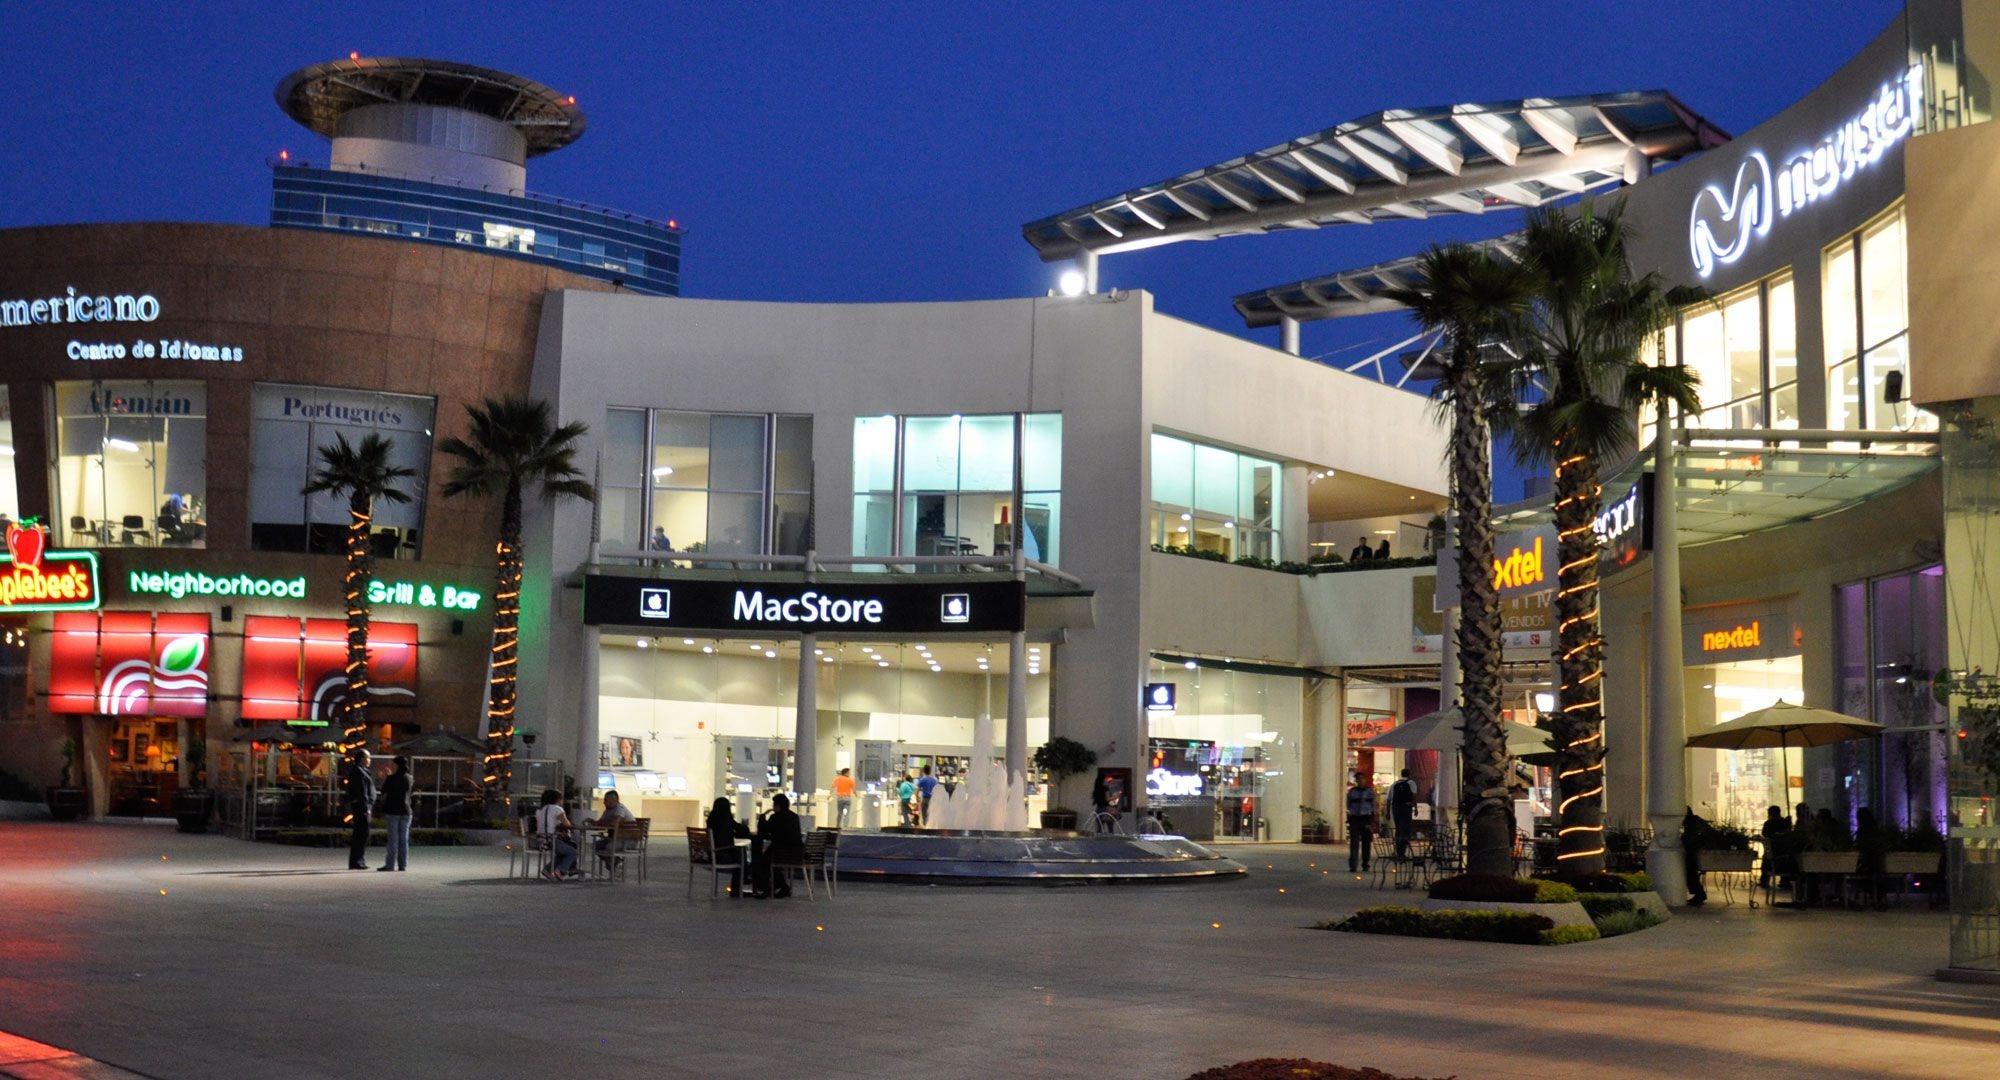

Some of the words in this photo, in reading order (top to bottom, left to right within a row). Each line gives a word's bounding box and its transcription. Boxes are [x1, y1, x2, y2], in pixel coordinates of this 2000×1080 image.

[0, 286, 160, 326] mericano
[66, 340, 126, 360] Centro
[131, 339, 155, 360] de
[159, 339, 244, 362] Idiomas
[283, 397, 402, 425] Portugués
[1493, 535, 1545, 591] xtel
[0, 564, 89, 606] plebee's
[130, 571, 306, 599] Neighborhood
[367, 580, 415, 605] Grill
[418, 584, 437, 607] &
[442, 585, 481, 610] Bar
[733, 590, 883, 624] MacStore
[1702, 621, 1761, 651] nextel
